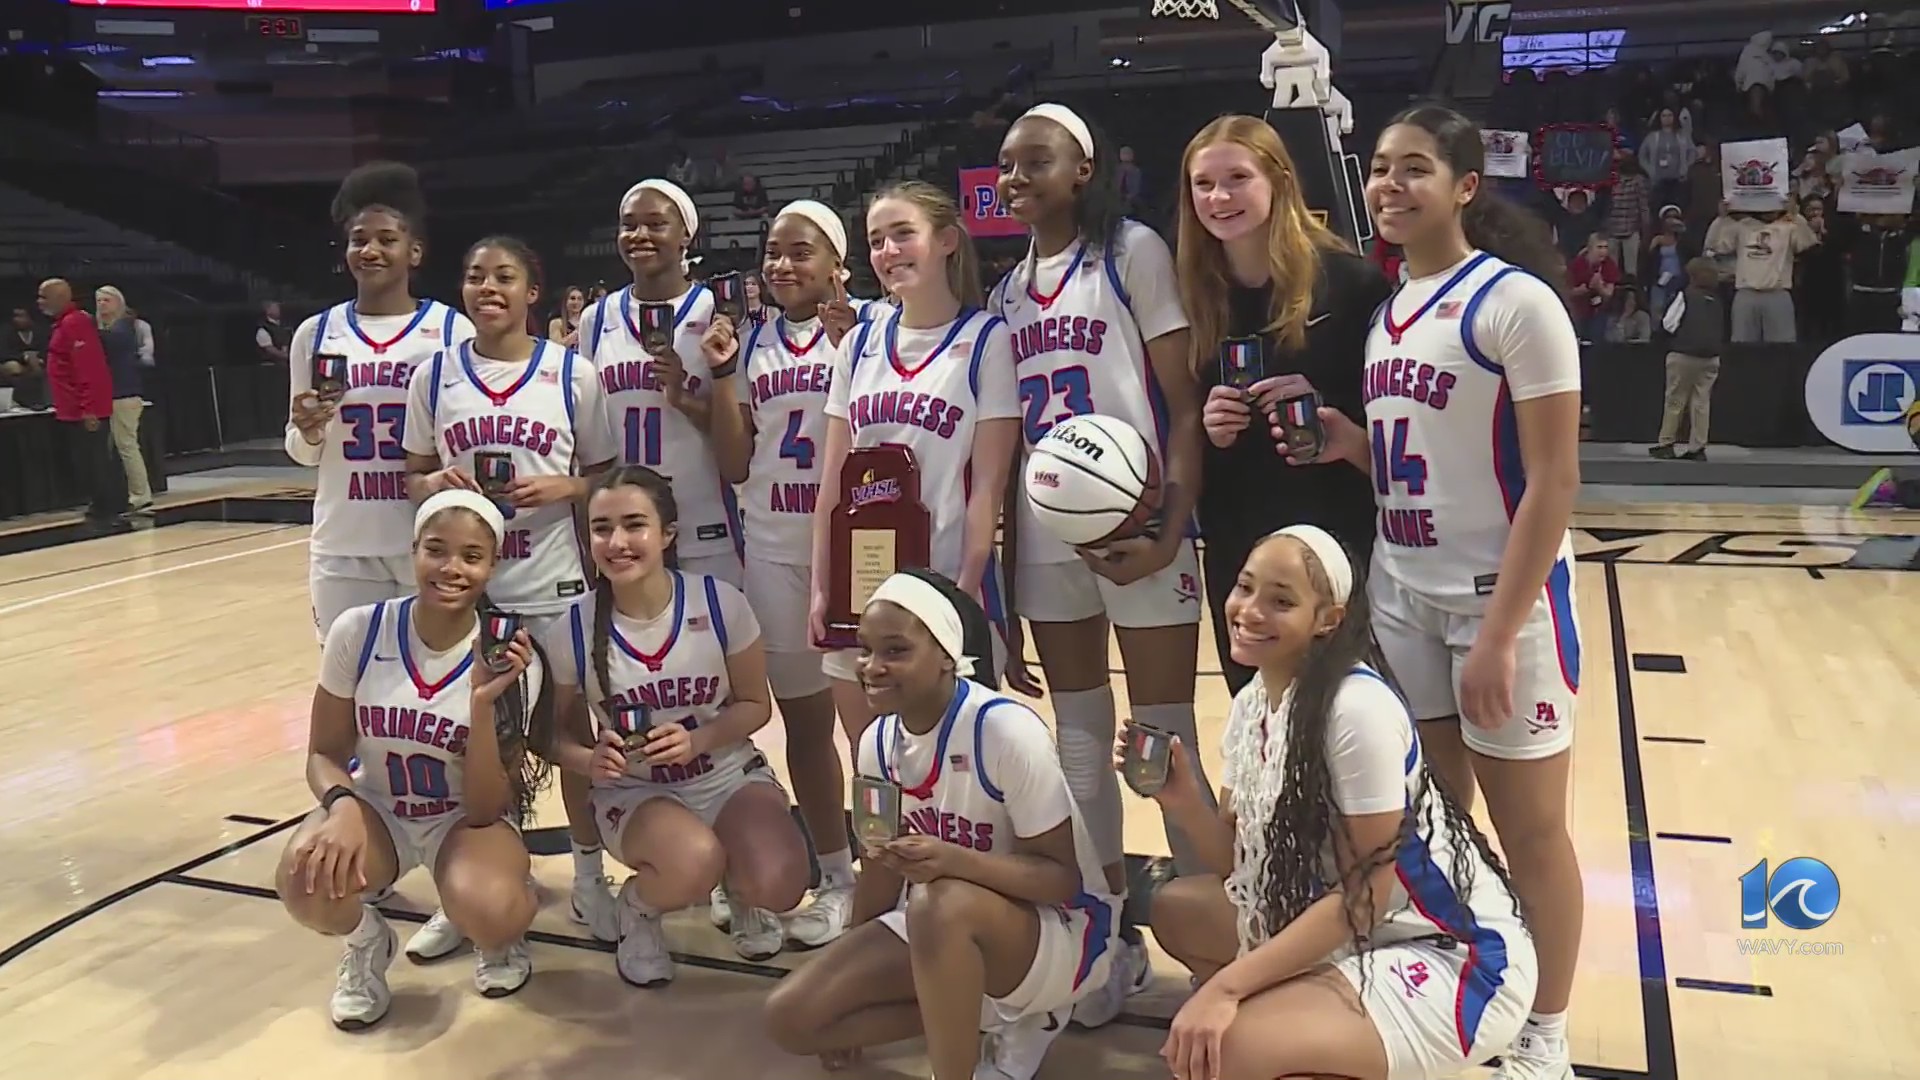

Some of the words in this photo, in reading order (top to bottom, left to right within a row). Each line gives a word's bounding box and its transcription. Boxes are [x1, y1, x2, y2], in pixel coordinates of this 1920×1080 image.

[849, 390, 964, 440] PRINCESS
[1018, 364, 1095, 446] 23
[340, 403, 407, 461] 33
[443, 415, 558, 457] PRINCESS
[623, 406, 662, 466] 11
[779, 409, 816, 470] 4
[1372, 416, 1427, 496] 14
[348, 471, 410, 500] ANNE
[771, 483, 821, 514] ANN
[1535, 701, 1556, 722] PA
[386, 751, 450, 798] 10
